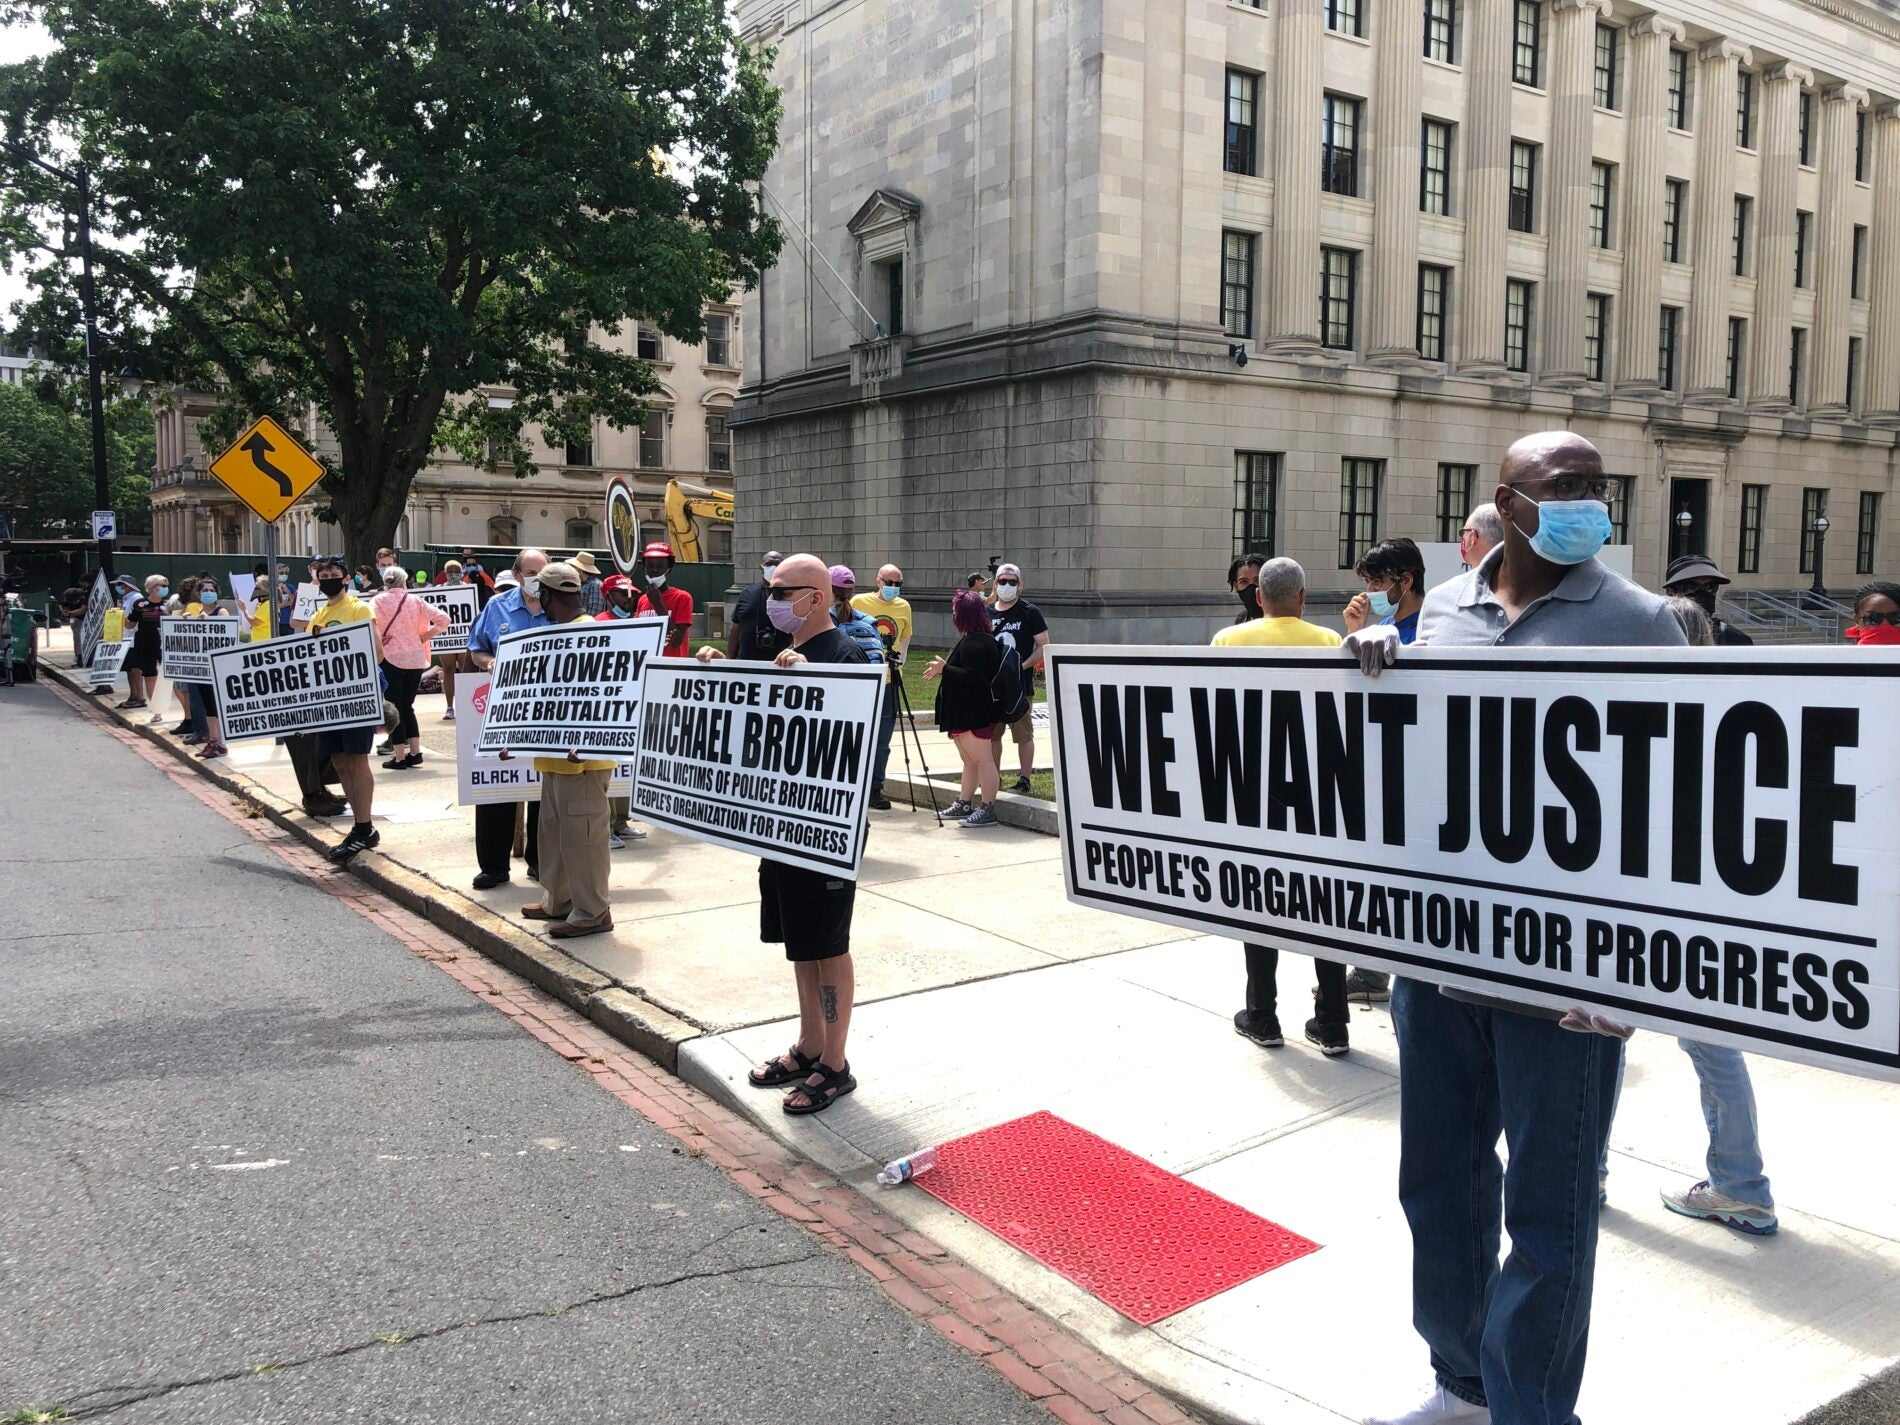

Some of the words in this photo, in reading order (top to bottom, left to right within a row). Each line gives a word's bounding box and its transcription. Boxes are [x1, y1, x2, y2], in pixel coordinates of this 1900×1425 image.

[421, 595, 446, 604] OR
[174, 624, 206, 634] JUSTICE
[209, 624, 226, 634] FOR
[100, 644, 120, 657] STOP
[165, 635, 200, 653] AHMAUD
[242, 642, 316, 669] JUSTICE
[320, 636, 350, 655] FOR
[434, 639, 467, 647] PROGRES
[520, 637, 573, 654] JUSTICE
[577, 636, 611, 648] FOR
[226, 663, 310, 700] GEORGE
[313, 652, 368, 687] FLOYD
[496, 654, 551, 689] JAMEEK
[552, 650, 648, 683] LOWERY
[226, 703, 244, 714] AND
[246, 700, 260, 711] ALL
[261, 695, 297, 709] VICTIMS
[299, 693, 308, 703] OF
[310, 689, 336, 702] POLICE
[337, 682, 374, 697] BRUTALITY
[474, 694, 488, 710] ST
[502, 690, 519, 700] AND
[521, 688, 537, 698] ALL
[540, 686, 600, 697] VICTIMS
[604, 686, 623, 696] OF
[672, 678, 761, 706] JUSTICE
[768, 684, 824, 712] FOR
[228, 715, 267, 733] PEOPLE'S
[269, 708, 325, 729] ORGANIZATION
[326, 705, 340, 720] FOR
[341, 699, 376, 719] PROGRESS
[488, 702, 528, 723] POLICE
[532, 700, 638, 722] BRUTALITY
[482, 731, 508, 745] PEOPLE'S
[508, 730, 562, 745] ORGANIZATION
[563, 731, 581, 745] FOR
[582, 731, 636, 747] PROGRESS
[642, 702, 732, 765] MICHAEL
[740, 712, 865, 784] BROWN
[472, 769, 519, 785] BLACK
[526, 770, 541, 782] LI
[639, 756, 656, 778] AND
[657, 758, 671, 783] ALL
[673, 762, 714, 793] VICTIMS
[715, 770, 730, 794] OF
[732, 772, 777, 804] POLICE
[779, 780, 854, 819] BRUTALITY
[1078, 683, 1181, 818] WE
[1190, 687, 1417, 847] WANT
[1438, 695, 1859, 906] JUSTICE
[637, 788, 672, 812] PEOPLE'S
[673, 796, 748, 832] ORGANIZATION
[749, 814, 774, 839] FOR
[776, 819, 848, 855] PROGRESS
[1085, 839, 1212, 903] PEOPLE'S
[1219, 860, 1480, 954] ORGANIZATION
[1492, 904, 1572, 972] FOR
[1586, 918, 1870, 1030] PROGRESS
